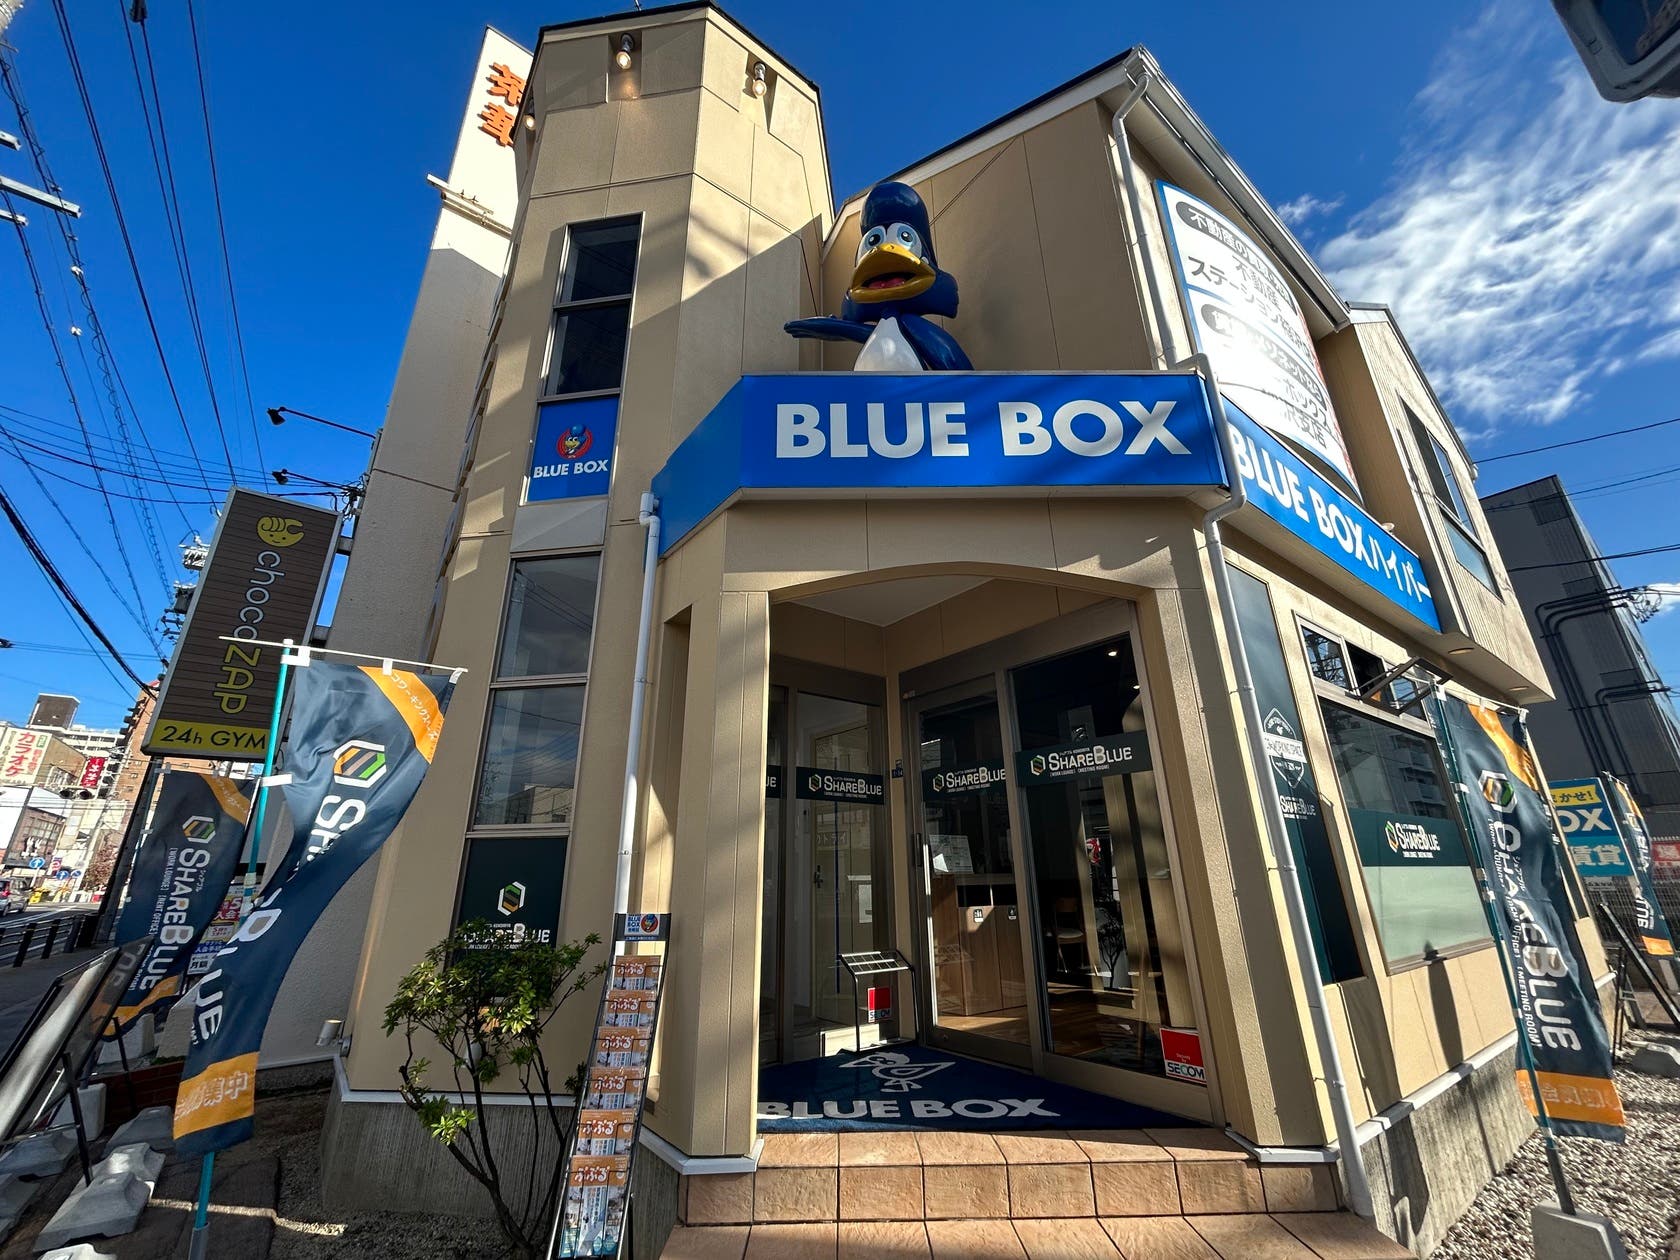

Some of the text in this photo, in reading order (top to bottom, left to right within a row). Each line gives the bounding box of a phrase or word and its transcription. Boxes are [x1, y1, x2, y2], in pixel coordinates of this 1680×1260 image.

[776, 399, 1192, 459] BLUE BOX
[533, 459, 608, 478] BLUE BOX
[1228, 422, 1310, 523] BLUE
[213, 551, 285, 714] chocoZAP
[160, 725, 266, 749] 24h GYM
[5, 732, 36, 777] カラオケ
[1167, 1062, 1205, 1080] SECOM
[758, 1098, 1061, 1119] BLUE BOX
